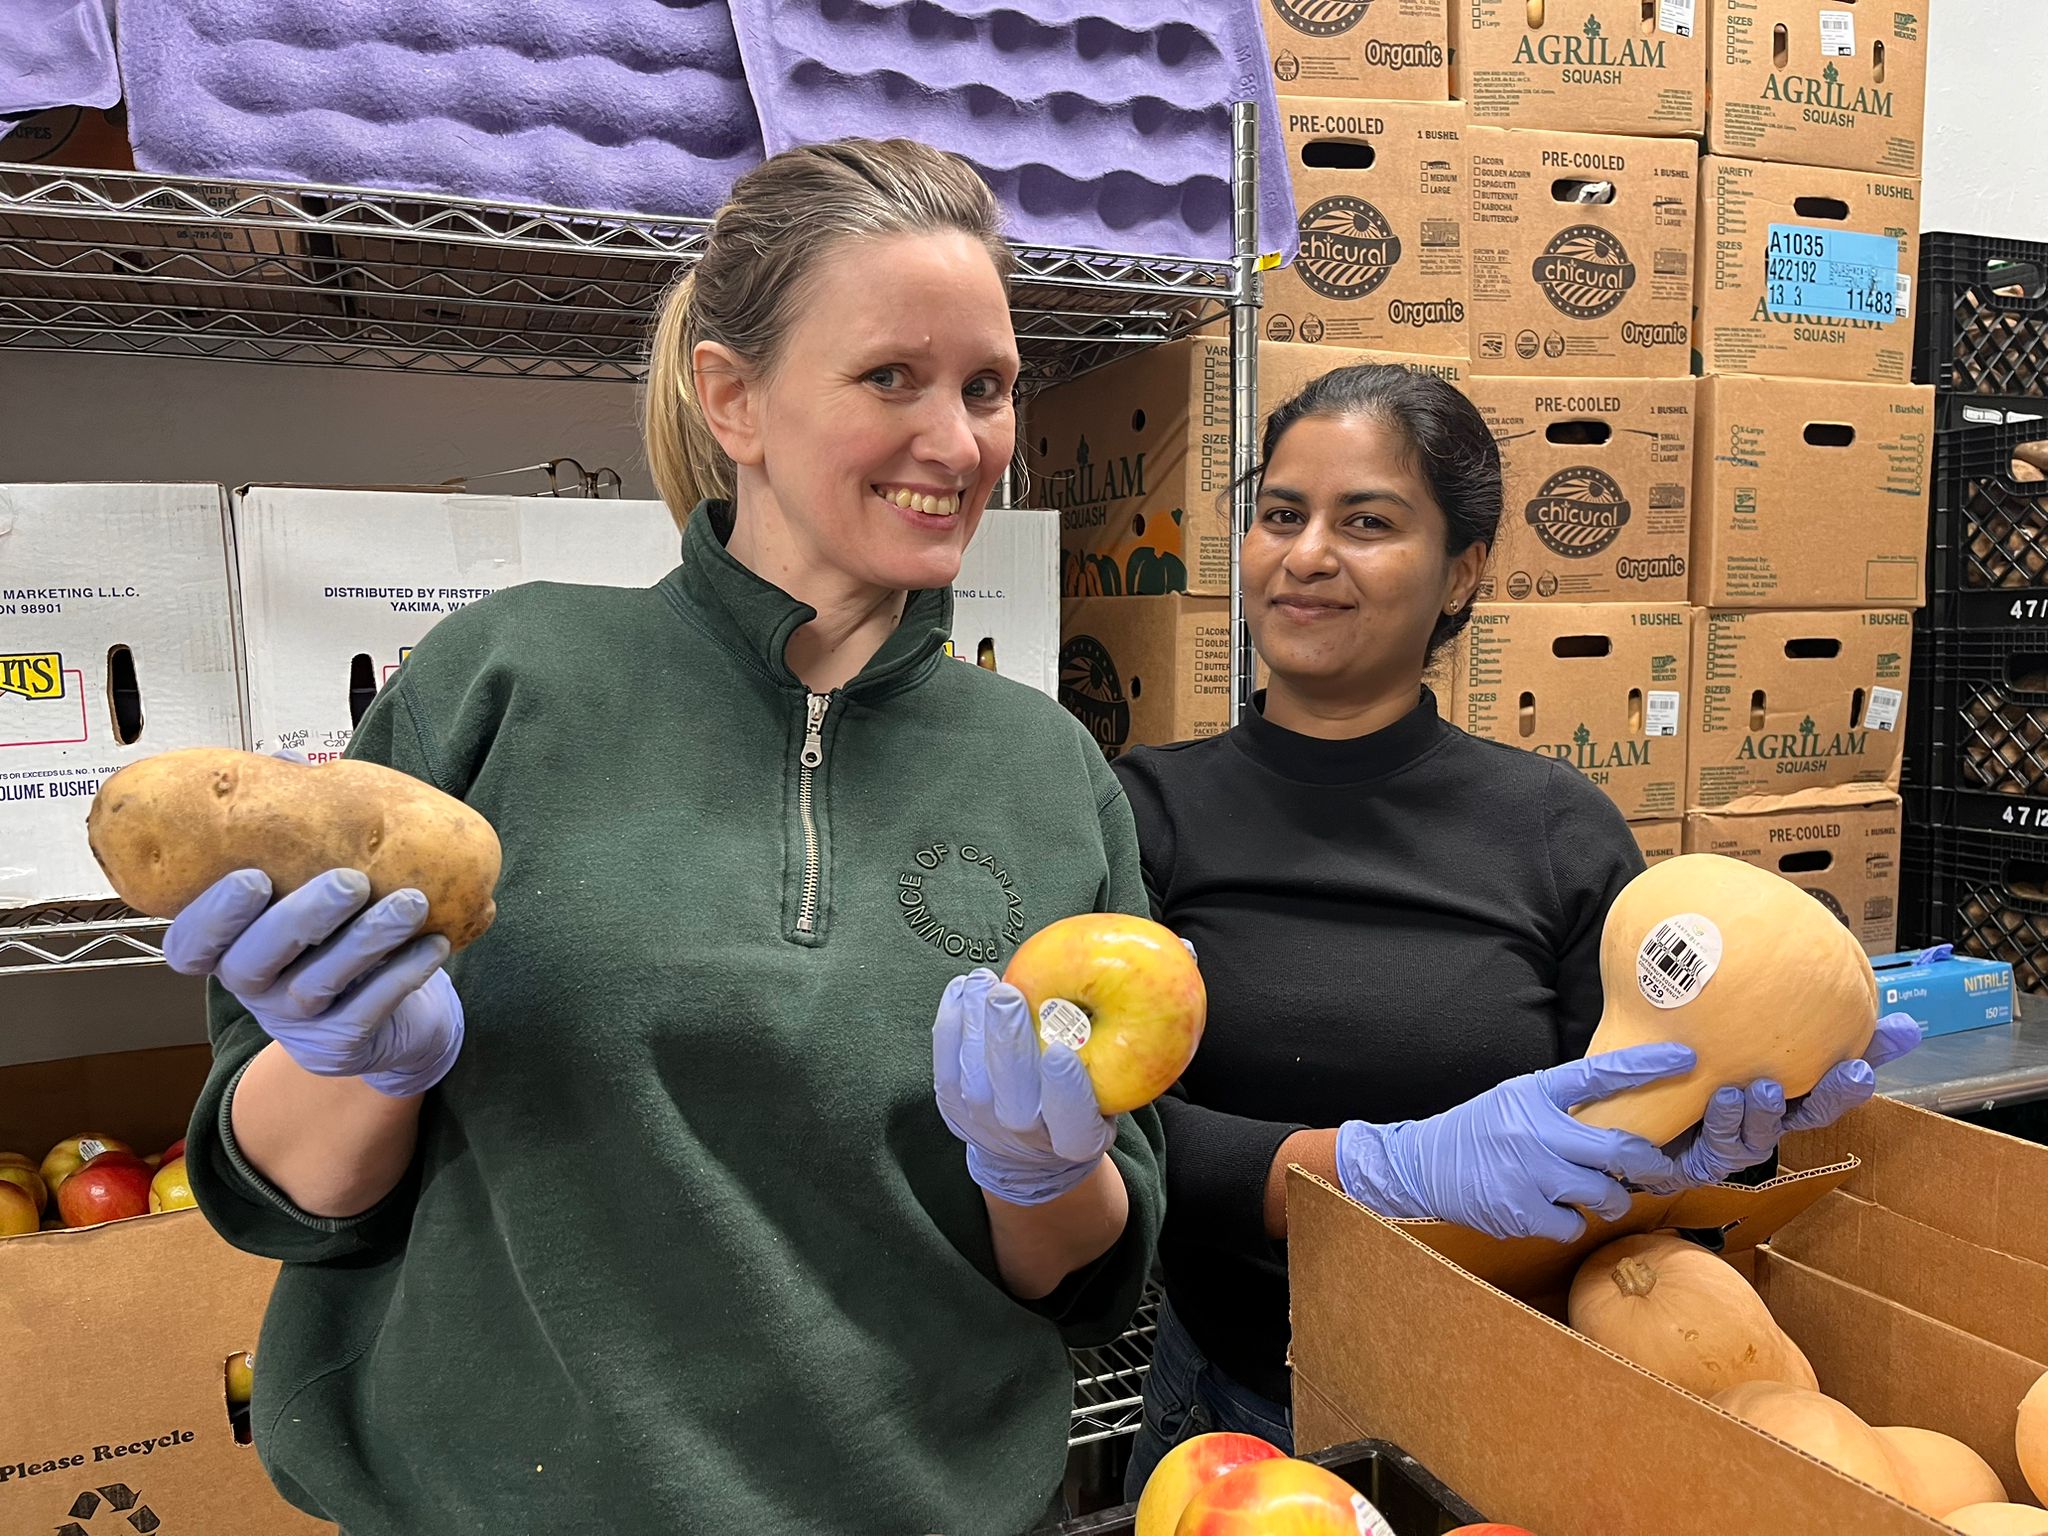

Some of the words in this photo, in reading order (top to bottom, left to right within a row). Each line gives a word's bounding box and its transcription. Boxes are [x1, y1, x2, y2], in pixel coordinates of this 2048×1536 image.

[1727, 15, 1753, 26] SIZES
[1365, 39, 1443, 71] Organic
[1512, 34, 1666, 68] AGRILAM
[1562, 69, 1621, 84] SQUASH
[1760, 73, 1893, 118] AGRILAM
[1803, 109, 1855, 128] SQUASH
[1289, 115, 1384, 135] PRE-COOLED
[1417, 131, 1422, 139] 1
[1425, 131, 1459, 140] BUSHEL
[1542, 151, 1625, 171] PRE-COOLED
[1482, 169, 1507, 177] GOLDEN
[1509, 170, 1531, 178] ACORN
[1661, 169, 1689, 178] BUSHEL
[1718, 166, 1753, 177] VARIETY
[1430, 174, 1457, 182] MEDIUM
[1430, 186, 1451, 194] LARGE
[1482, 192, 1518, 200] BUTTERNUT
[1866, 183, 1870, 194] 1
[1874, 184, 1914, 199] BUSHEL
[1482, 203, 1512, 211] KABOCHA
[1482, 215, 1519, 223] BUTTERCUP
[1299, 235, 1387, 265] chicural
[1717, 241, 1742, 250] SIZES
[1770, 231, 1823, 257] A1035
[1545, 259, 1623, 289] chicural
[1769, 258, 1816, 283] 422192
[1769, 284, 1784, 305] 13
[1794, 286, 1802, 306] 3
[1847, 289, 1893, 314] 11483
[1389, 298, 1464, 327] Organic
[1622, 320, 1687, 348] Organic
[1793, 328, 1845, 343] SQUASH
[1535, 397, 1621, 412] PRE-COOLED
[1650, 406, 1655, 414] 1
[1658, 406, 1688, 414] BUSHEL
[1895, 405, 1924, 414] Bushel
[1740, 426, 1764, 435] X-Large
[1661, 433, 1680, 441] SMALL
[1740, 438, 1758, 446] Large
[1039, 453, 1146, 508] AGRILAM
[1064, 505, 1106, 529] SQUASH
[1538, 501, 1618, 526] chicural
[1616, 554, 1685, 582] Organic
[4, 588, 93, 599] MARKETING
[99, 587, 140, 597] L.L.C.
[325, 588, 412, 599] DISTRIBUTED
[417, 589, 435, 598] BY
[954, 590, 976, 598] TING
[21, 604, 61, 614] 98901
[390, 602, 444, 613] YAKIMA,
[1471, 615, 1510, 624] VARIETY
[1631, 614, 1636, 625] 1
[1640, 613, 1682, 625] BUSHEL
[1710, 614, 1745, 622] VARIETY
[1862, 614, 1866, 624] 1
[1869, 614, 1909, 625] BUSHEL
[1204, 651, 1229, 659] SPAGU
[1203, 686, 1230, 694] BUTTER
[1705, 685, 1730, 694] SIZES
[1468, 693, 1497, 702] SIZES
[1735, 732, 1869, 760] AGRILAM
[1532, 740, 1651, 769] RILAM
[1776, 760, 1828, 774] SQUASH
[22, 770, 58, 778] EXCEEDS
[1769, 824, 1841, 843] PRE-COOLED
[1870, 827, 1896, 837] BUSHEL
[915, 843, 949, 869] OF
[1646, 848, 1674, 857] BUSHEL
[960, 845, 1025, 946] CANADA
[899, 873, 1000, 962] PROVINCE
[1642, 975, 1664, 998] 4759
[1662, 977, 1682, 995] SQUASH
[1964, 970, 2009, 992] NITRILE
[1653, 975, 1680, 1000] BUTTERNUT
[1899, 990, 1913, 1000] Light
[1914, 988, 1928, 997] Duty
[1985, 1007, 1998, 1019] 150
[0, 1451, 84, 1482] Please
[92, 1428, 194, 1464] Recycle
